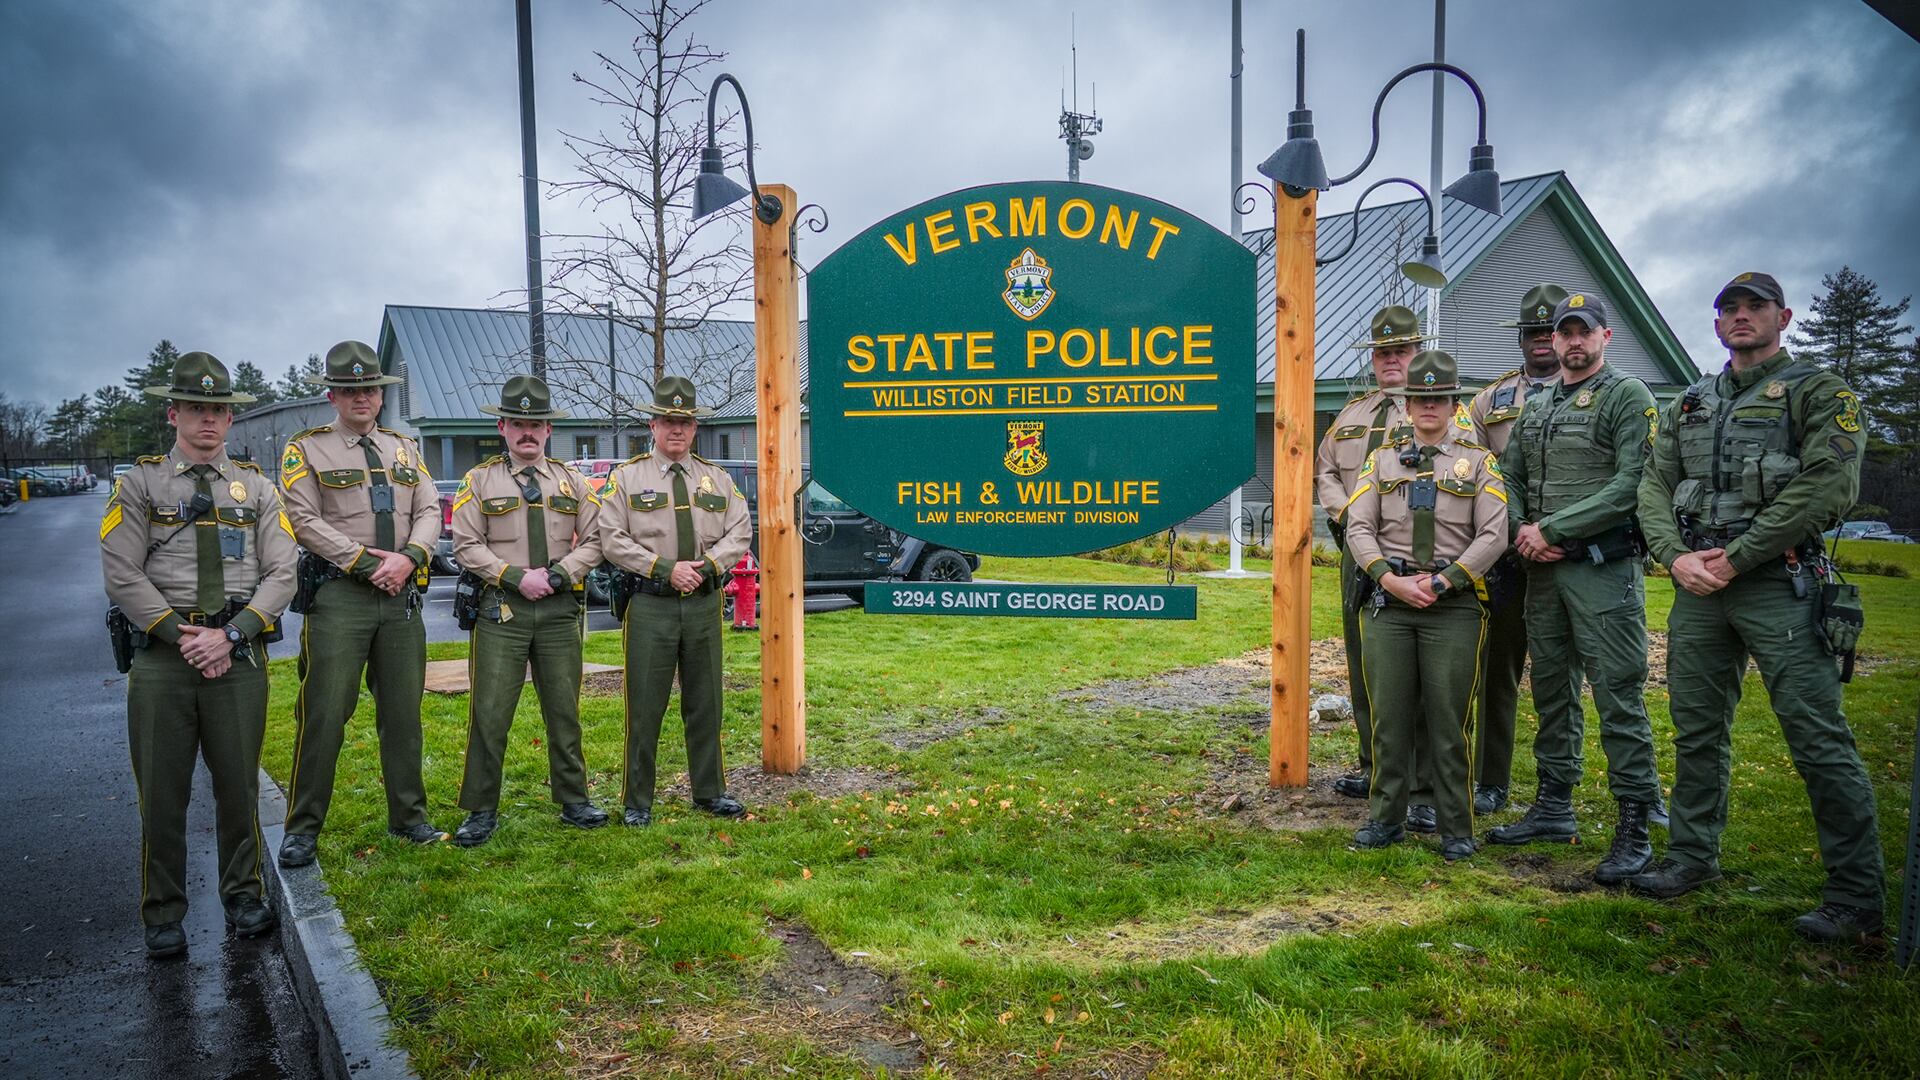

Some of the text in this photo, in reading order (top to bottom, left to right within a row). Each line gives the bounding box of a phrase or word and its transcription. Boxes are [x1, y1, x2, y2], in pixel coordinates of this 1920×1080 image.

[883, 196, 1181, 266] VERMONT
[1010, 266, 1047, 276] VERMONT
[1006, 292, 1051, 314] STATE POLICE
[847, 324, 1214, 373] STATE POLICE
[872, 383, 1186, 408] WILLISTON FIELD STATION
[1007, 461, 1018, 471] FISH
[1023, 461, 1046, 474] WILDLIFE
[898, 480, 1160, 505] FISH & WILDLIFE
[917, 511, 1139, 524] LAW ENFORCEMENT DIVISION
[892, 590, 1165, 612] 3294 SAINT GEORGE ROAD
